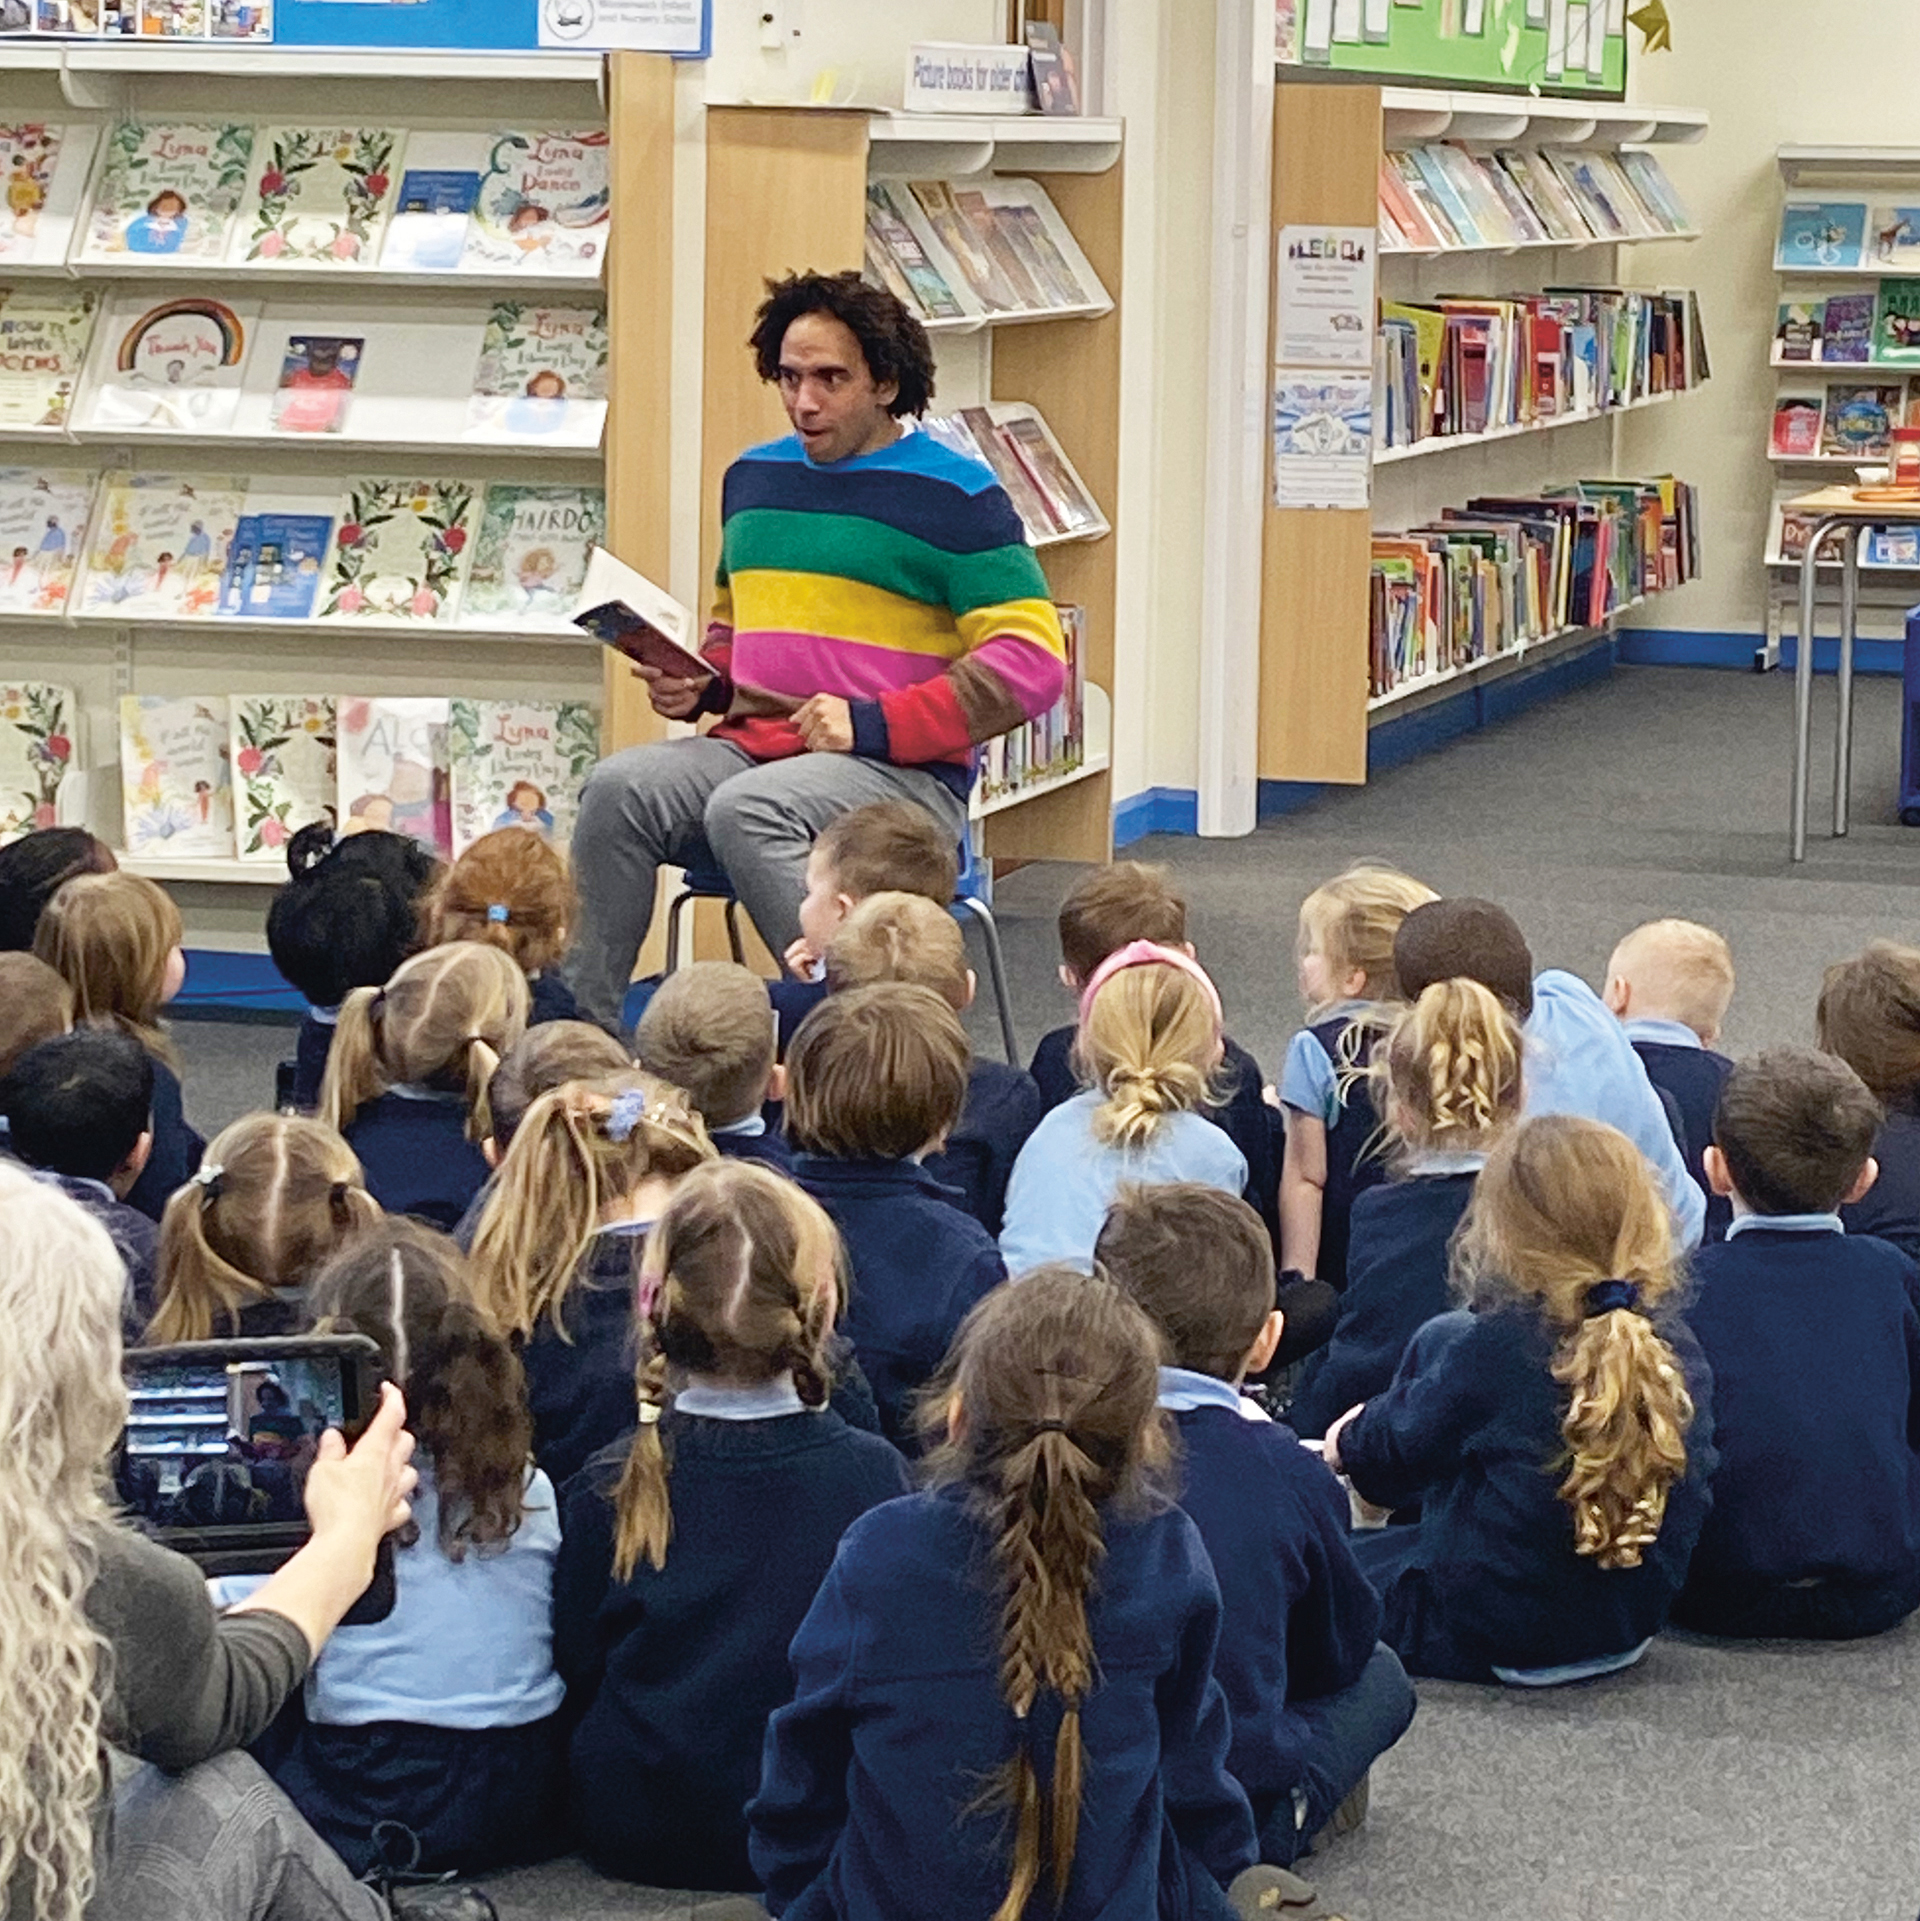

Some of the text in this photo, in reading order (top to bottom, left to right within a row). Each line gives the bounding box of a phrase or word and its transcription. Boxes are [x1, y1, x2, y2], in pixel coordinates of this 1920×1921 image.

[913, 55, 945, 91] Picture
[946, 57, 974, 91] books
[975, 59, 989, 91] for
[990, 61, 1013, 91] older
[521, 172, 582, 193] Dance
[493, 713, 550, 746] Luna
